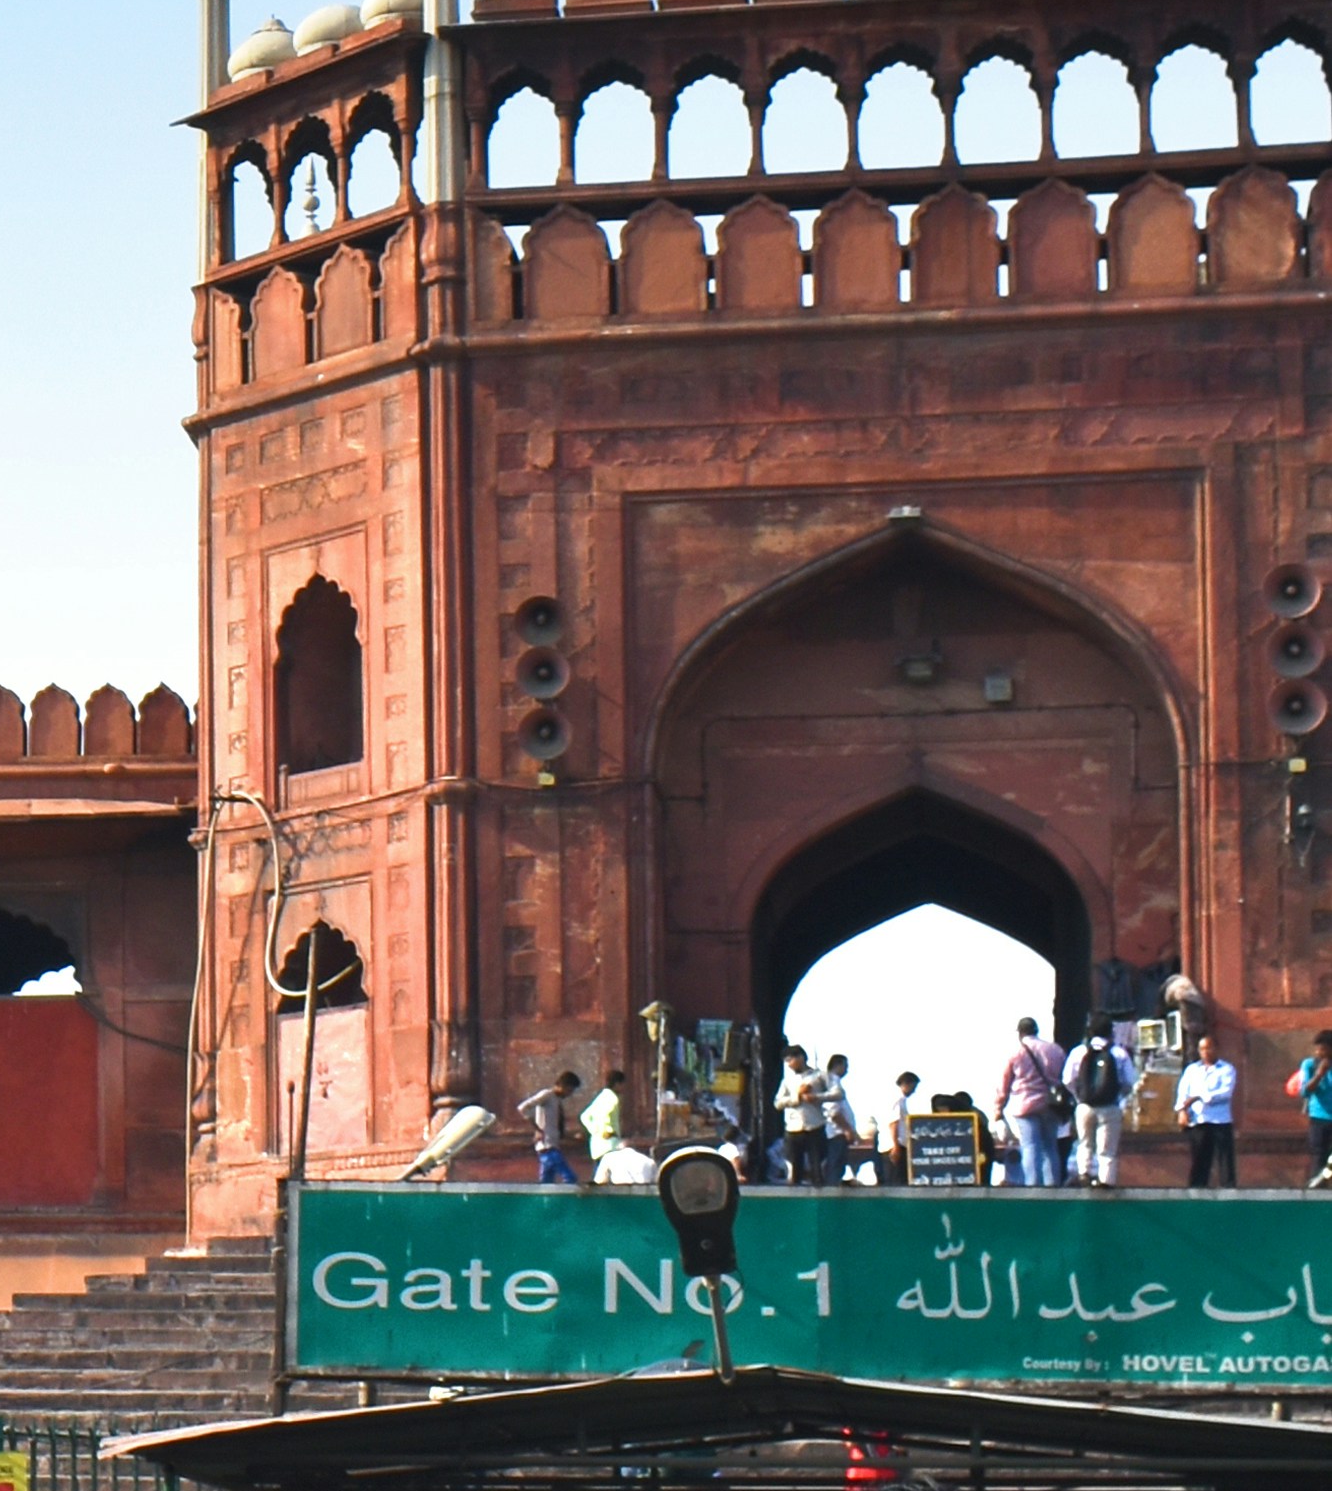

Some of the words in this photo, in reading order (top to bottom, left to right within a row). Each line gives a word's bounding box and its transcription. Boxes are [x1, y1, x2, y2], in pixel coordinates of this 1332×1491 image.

[312, 1251, 560, 1312] Gate
[1038, 1271, 1177, 1343] عبد
[1023, 1356, 1081, 1372] Courtesy
